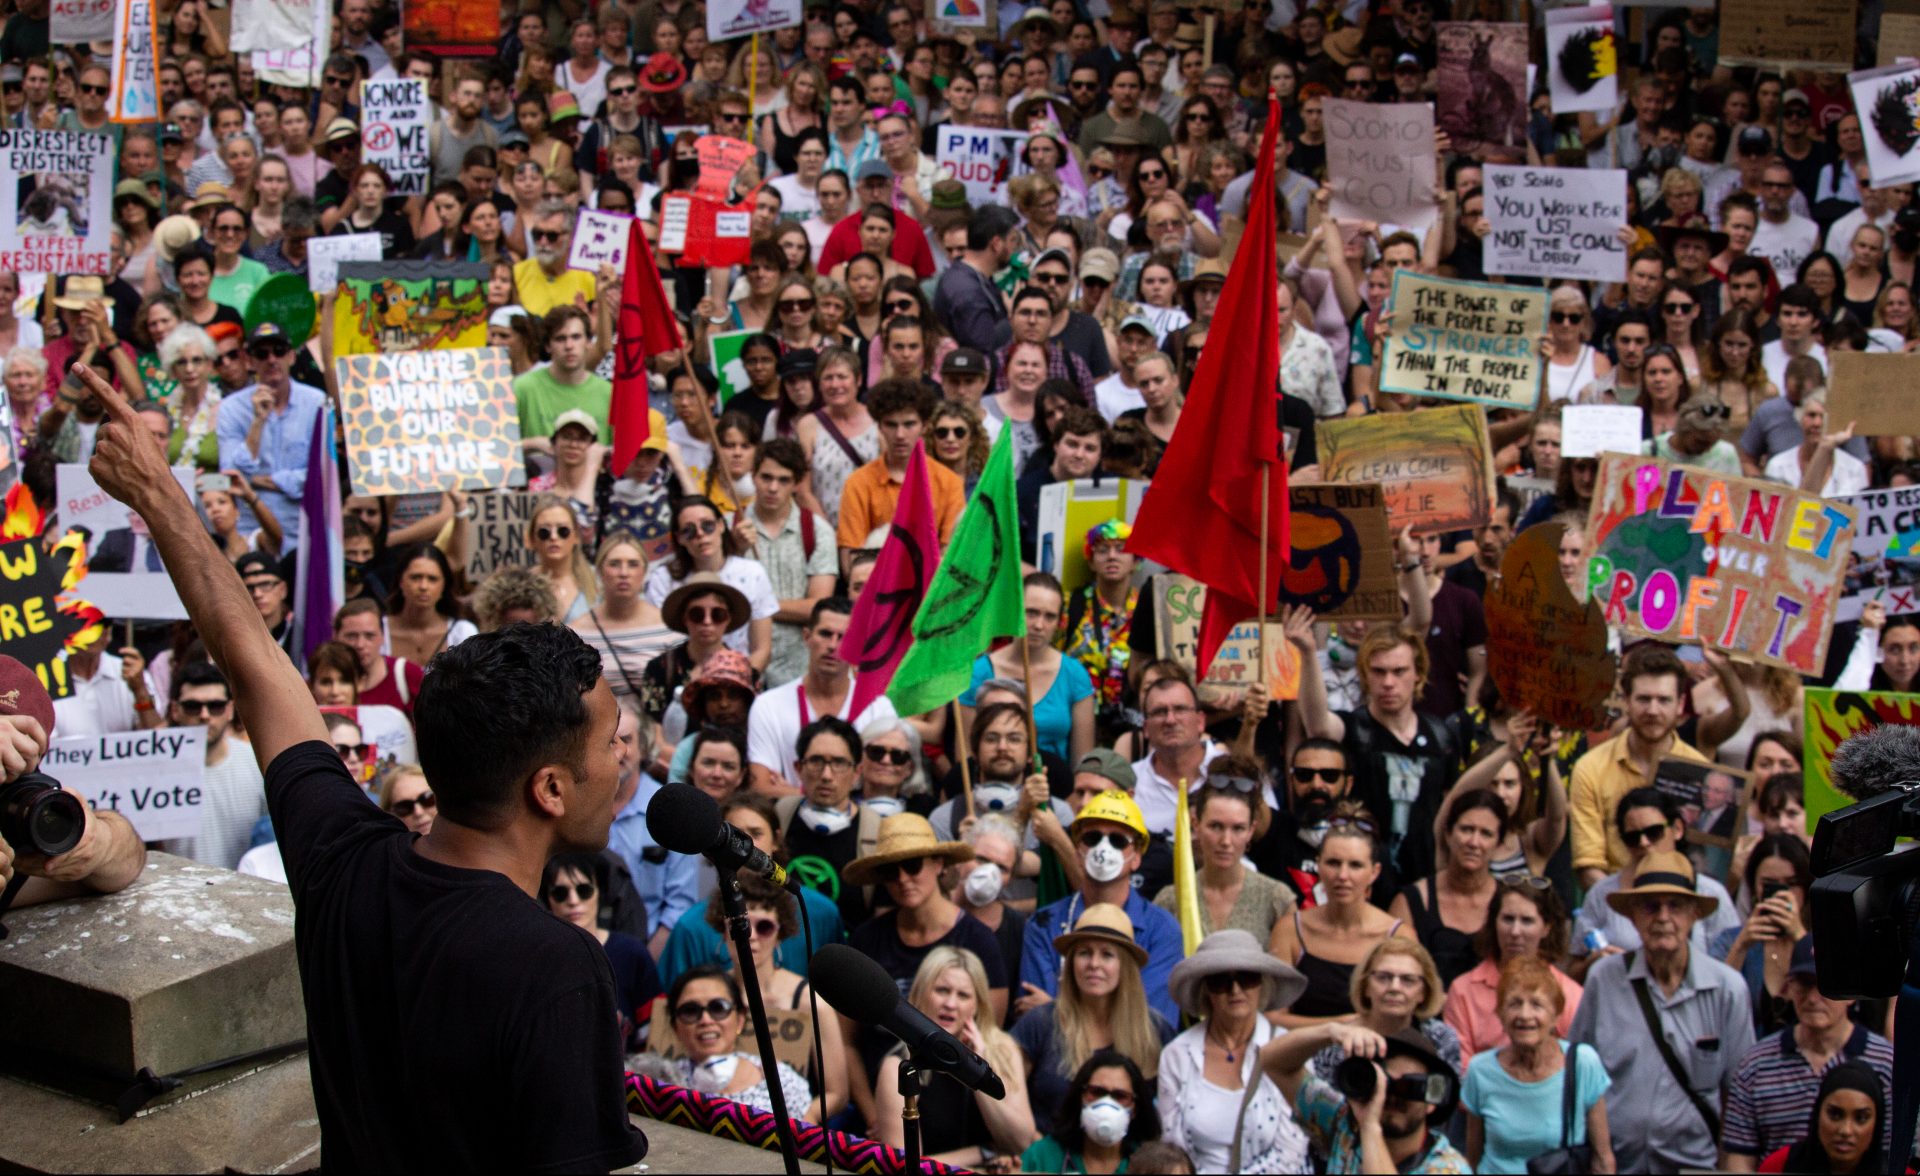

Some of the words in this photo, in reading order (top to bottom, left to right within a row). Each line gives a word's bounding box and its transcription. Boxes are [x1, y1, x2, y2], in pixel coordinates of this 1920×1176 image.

[364, 81, 422, 107] IGNORE
[368, 110, 381, 120] IT
[390, 109, 417, 119] AND
[0, 129, 109, 154] DISRESPECT
[396, 126, 425, 153] WE
[10, 151, 95, 173] EXISTENCE
[1494, 195, 1534, 218] YOU
[1540, 197, 1589, 218] WORK
[1592, 201, 1621, 218] FOR
[24, 235, 86, 250] EXPECT
[1494, 229, 1527, 249] NOT
[1532, 237, 1561, 250] THE
[1569, 233, 1623, 252] COAL
[0, 251, 109, 273] RESISTANCE
[1529, 249, 1581, 265] LOBBY
[1414, 287, 1448, 307] THE
[1454, 293, 1498, 313] POWER
[1510, 299, 1530, 314] OF
[1412, 309, 1438, 326] THE
[1445, 312, 1495, 334] PEOPLE
[1504, 320, 1525, 335] IS
[1402, 324, 1534, 359] STRONGER
[1396, 350, 1436, 372] THAN
[1444, 355, 1470, 374] THE
[1482, 359, 1529, 380] PEOPLE
[369, 381, 479, 412] BURNING
[1424, 374, 1448, 392] IN
[1464, 377, 1511, 399] POWER
[402, 410, 458, 434] OUR
[370, 441, 501, 477] FUTURE
[1345, 462, 1400, 483] CLEAN
[1408, 457, 1450, 475] COAL
[1405, 494, 1436, 512] LIE
[1635, 464, 1852, 560] PLANET
[1861, 493, 1888, 510] TO
[1702, 545, 1768, 577] OVER
[1585, 554, 1803, 658] PROFIT
[45, 745, 93, 767] They
[101, 731, 196, 760] Lucky-
[130, 785, 202, 811] Vote
